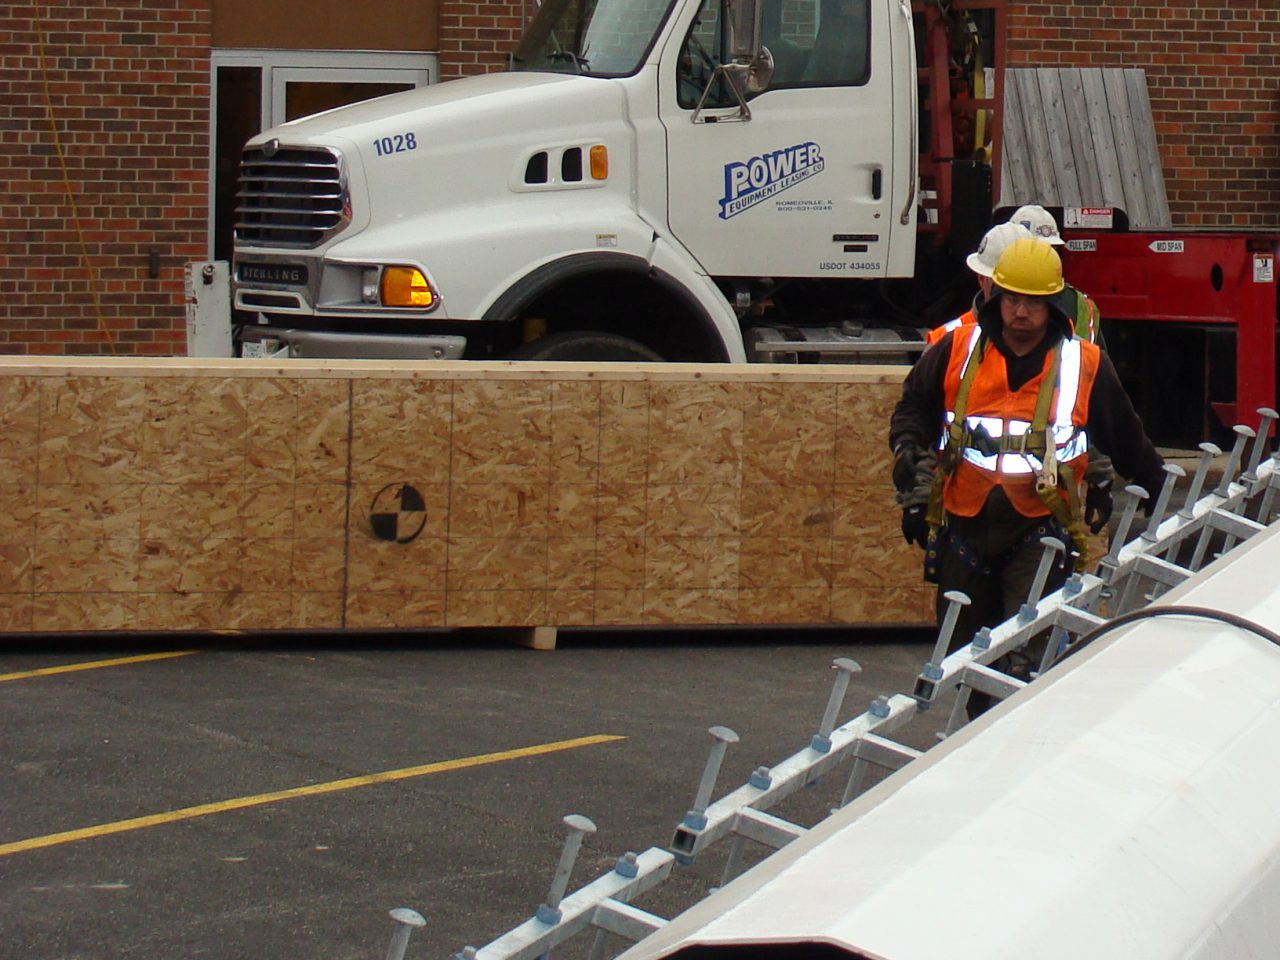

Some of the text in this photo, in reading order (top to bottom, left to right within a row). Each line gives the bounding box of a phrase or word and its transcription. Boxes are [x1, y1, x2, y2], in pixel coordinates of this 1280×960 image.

[373, 132, 417, 156] 1028
[725, 142, 821, 200] POWER
[729, 184, 777, 214] EQUIPMENT
[781, 169, 809, 188] LEASING
[1069, 241, 1096, 250] FULL SPAN
[1157, 242, 1182, 250] MID SPAN
[820, 262, 880, 270] USDOT 434055
